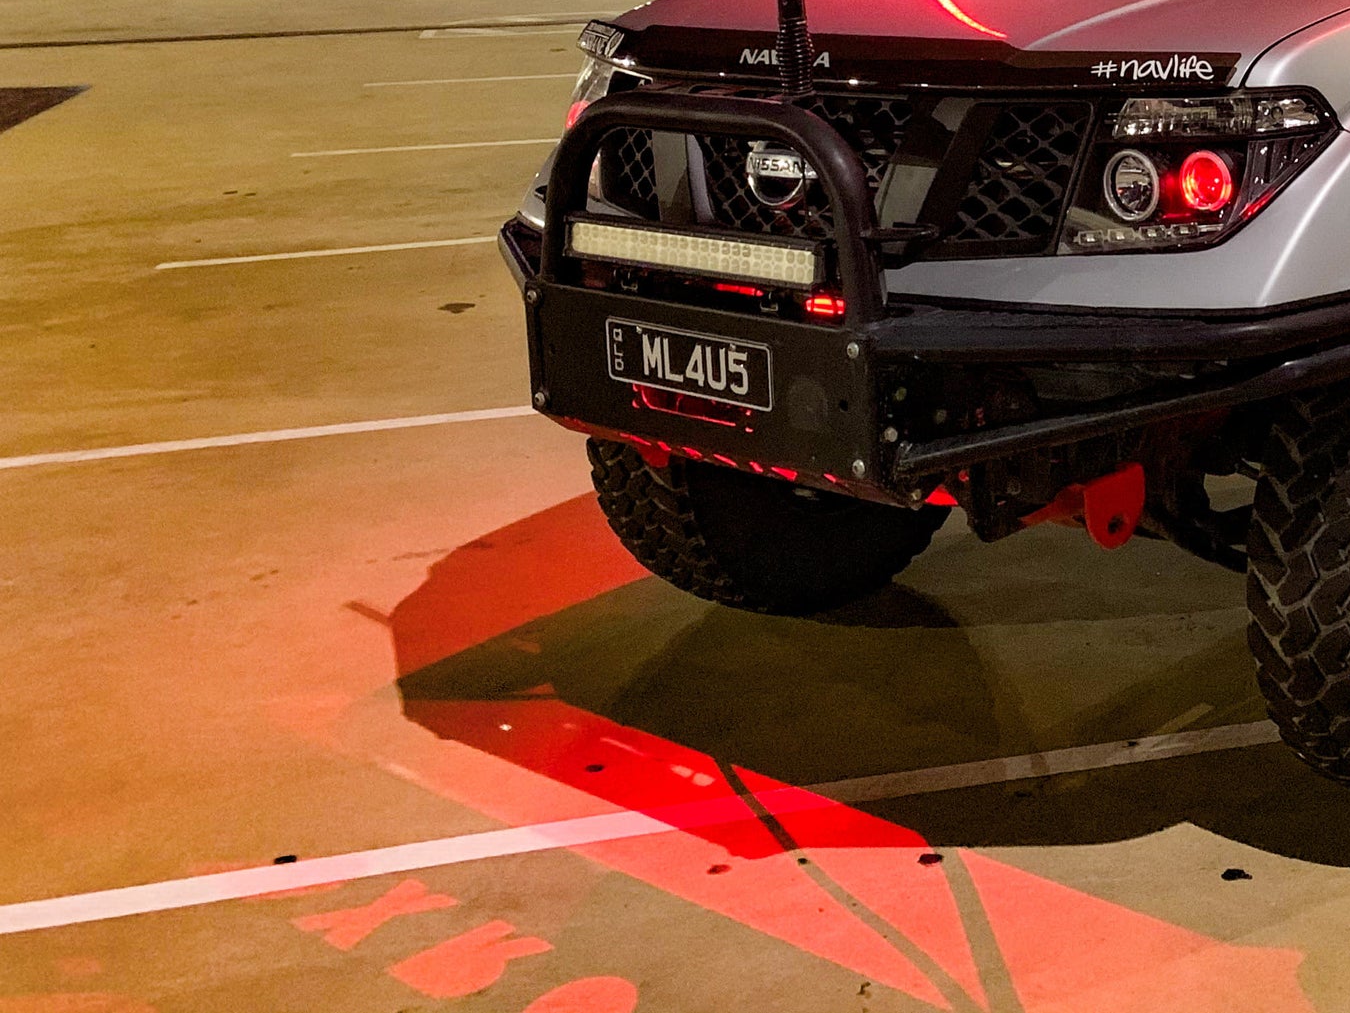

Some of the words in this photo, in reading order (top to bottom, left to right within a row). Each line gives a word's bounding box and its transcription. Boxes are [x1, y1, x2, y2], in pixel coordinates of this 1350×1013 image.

[739, 48, 830, 68] NAA
[1090, 54, 1214, 80] #navlife
[749, 156, 803, 174] NISSAN
[612, 328, 625, 372] QLD
[641, 333, 749, 395] ML4U5
